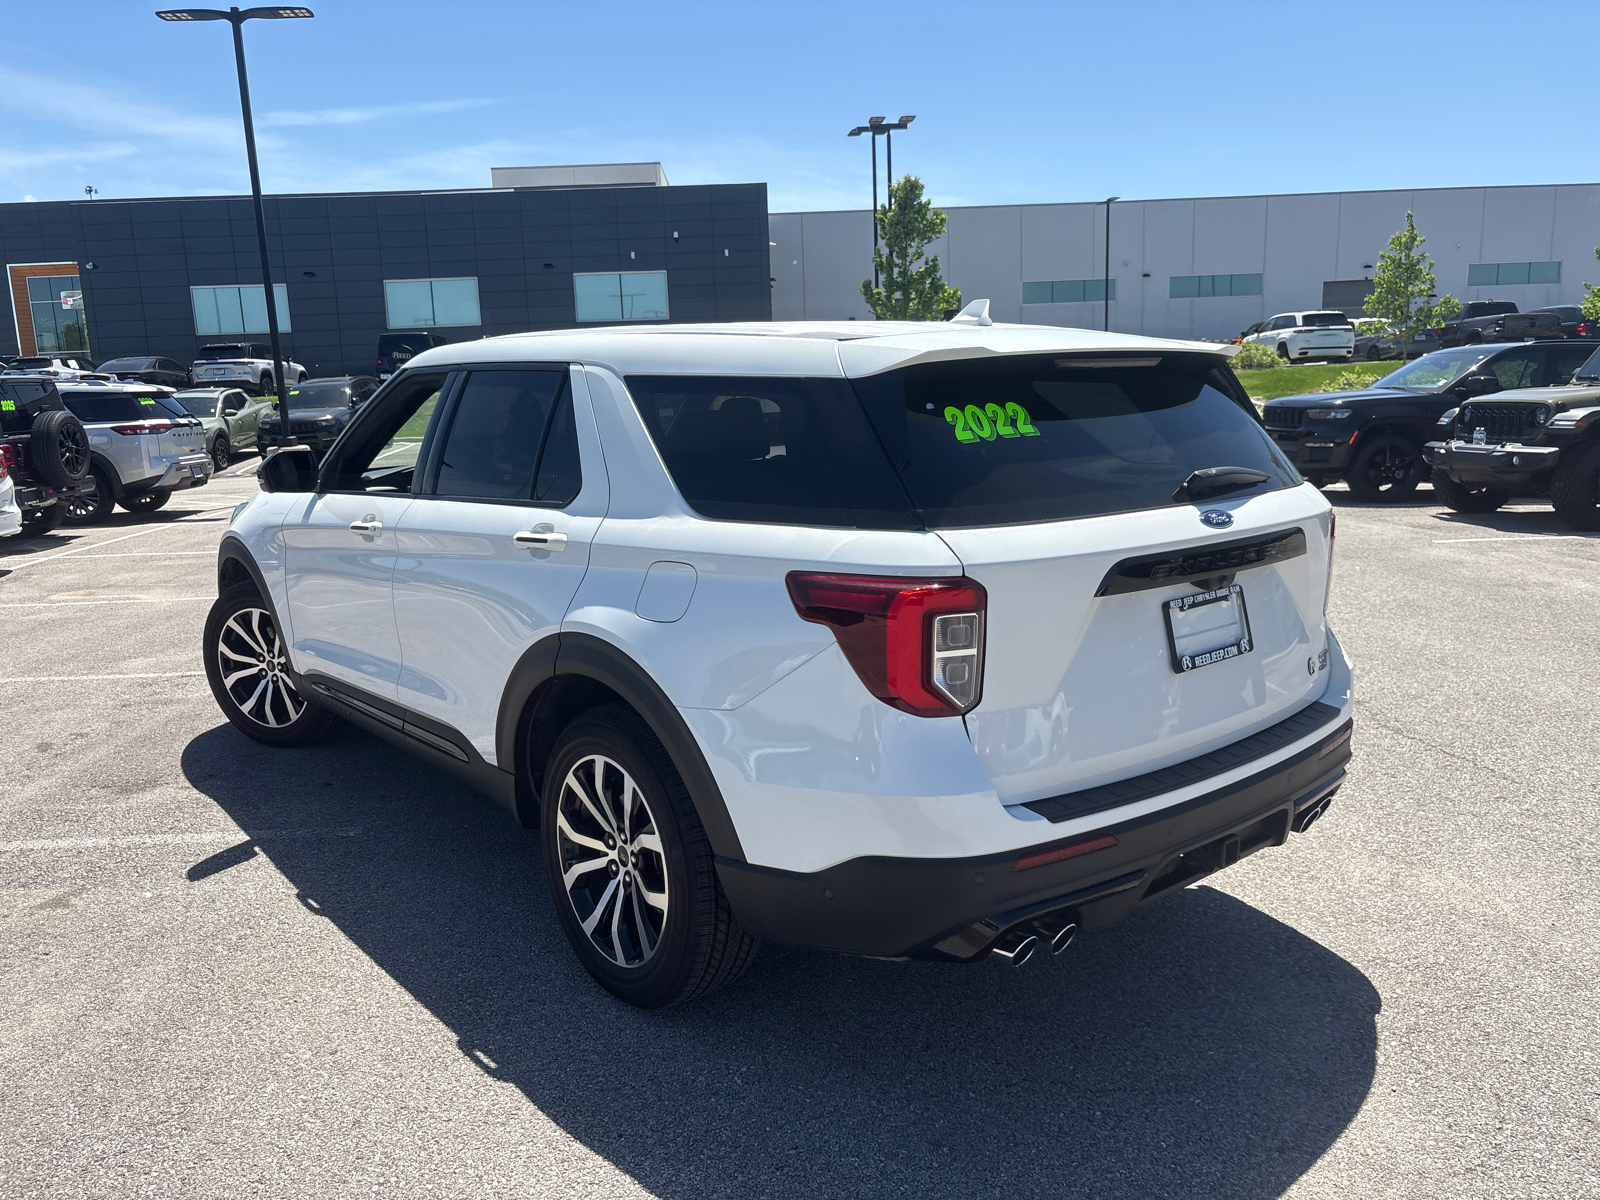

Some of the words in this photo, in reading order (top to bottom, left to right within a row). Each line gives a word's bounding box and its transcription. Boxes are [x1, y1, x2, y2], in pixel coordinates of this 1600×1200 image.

[391, 351, 412, 359] REED
[943, 401, 1041, 444] 2022
[1150, 541, 1290, 579] EXPLORER
[1169, 599, 1182, 609] REED
[1183, 596, 1194, 606] JEEP
[1194, 591, 1216, 602] CHRYSLER
[1216, 587, 1230, 597] DODGE
